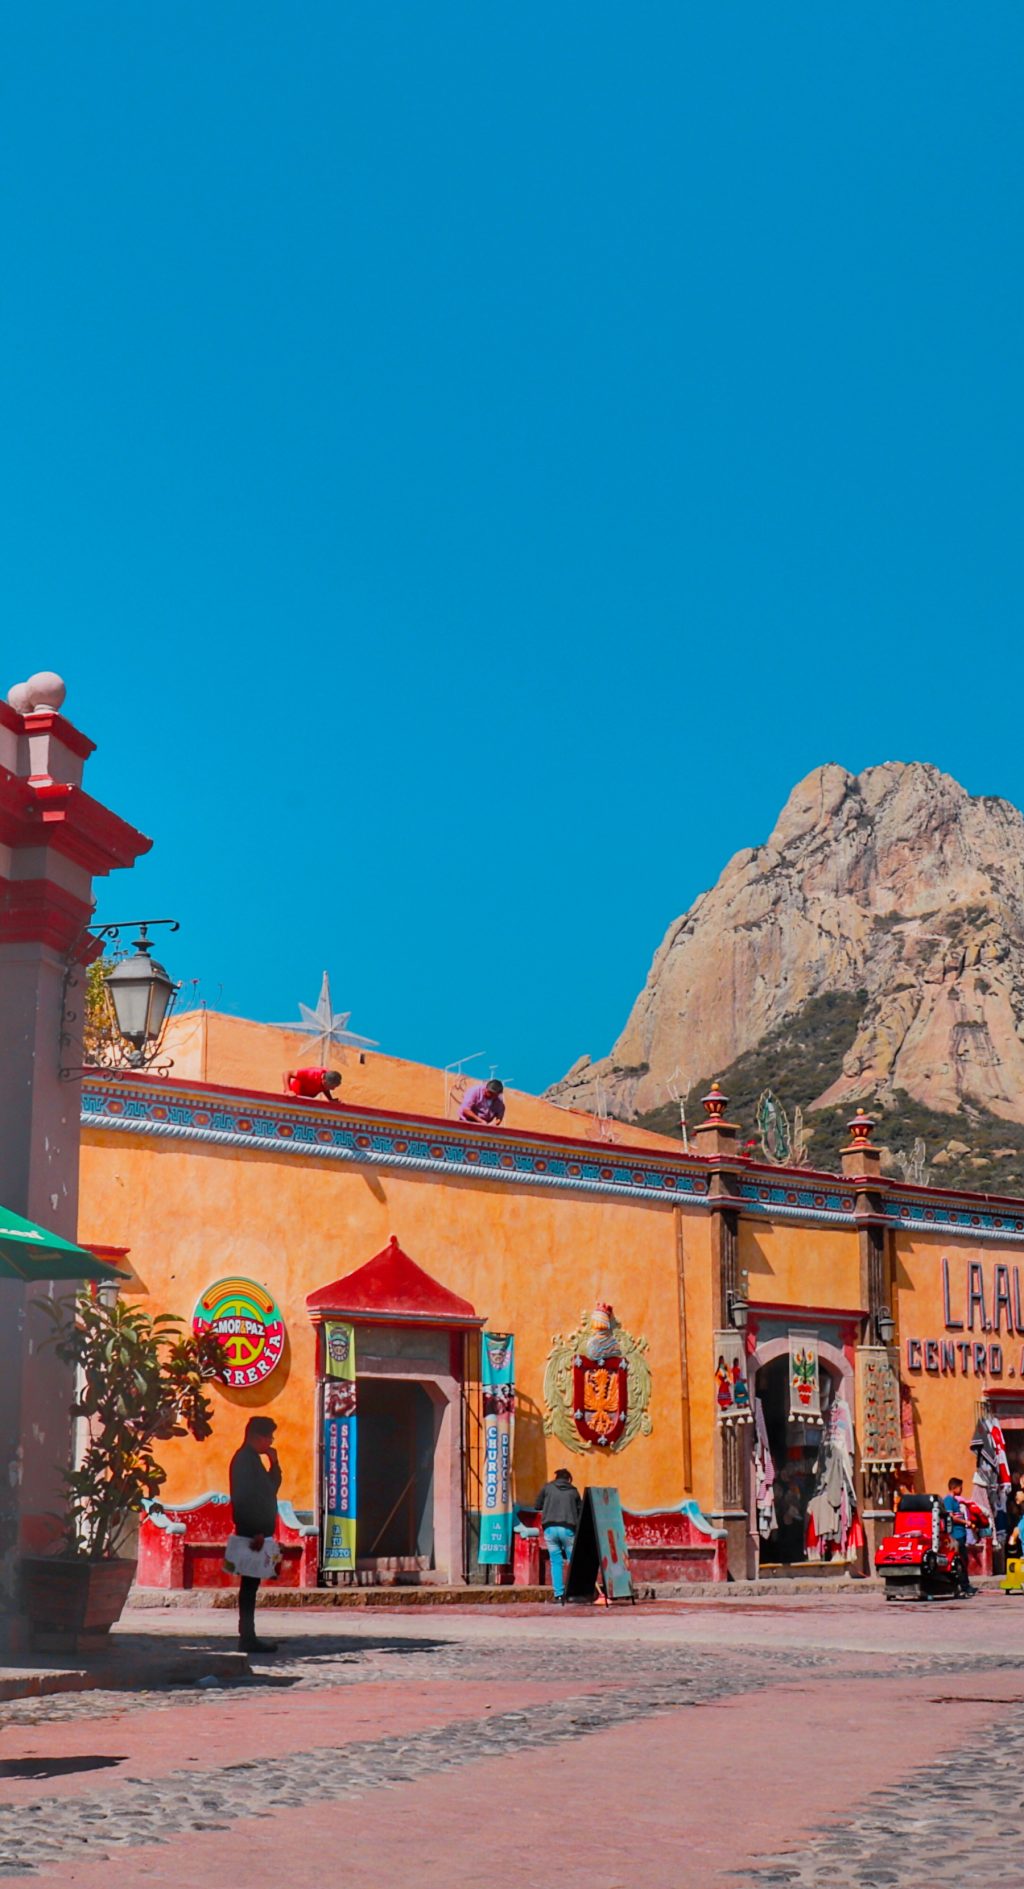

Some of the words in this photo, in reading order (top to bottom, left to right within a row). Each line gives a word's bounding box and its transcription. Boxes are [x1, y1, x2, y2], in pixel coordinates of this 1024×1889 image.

[941, 1258, 986, 1330] LA
[906, 1338, 1003, 1374] CENTRO
[328, 1423, 338, 1510] CHURROS
[340, 1424, 349, 1511] SALADOS
[486, 1426, 498, 1508] CHURROS
[332, 1537, 342, 1546] TU
[491, 1533, 502, 1541] TU
